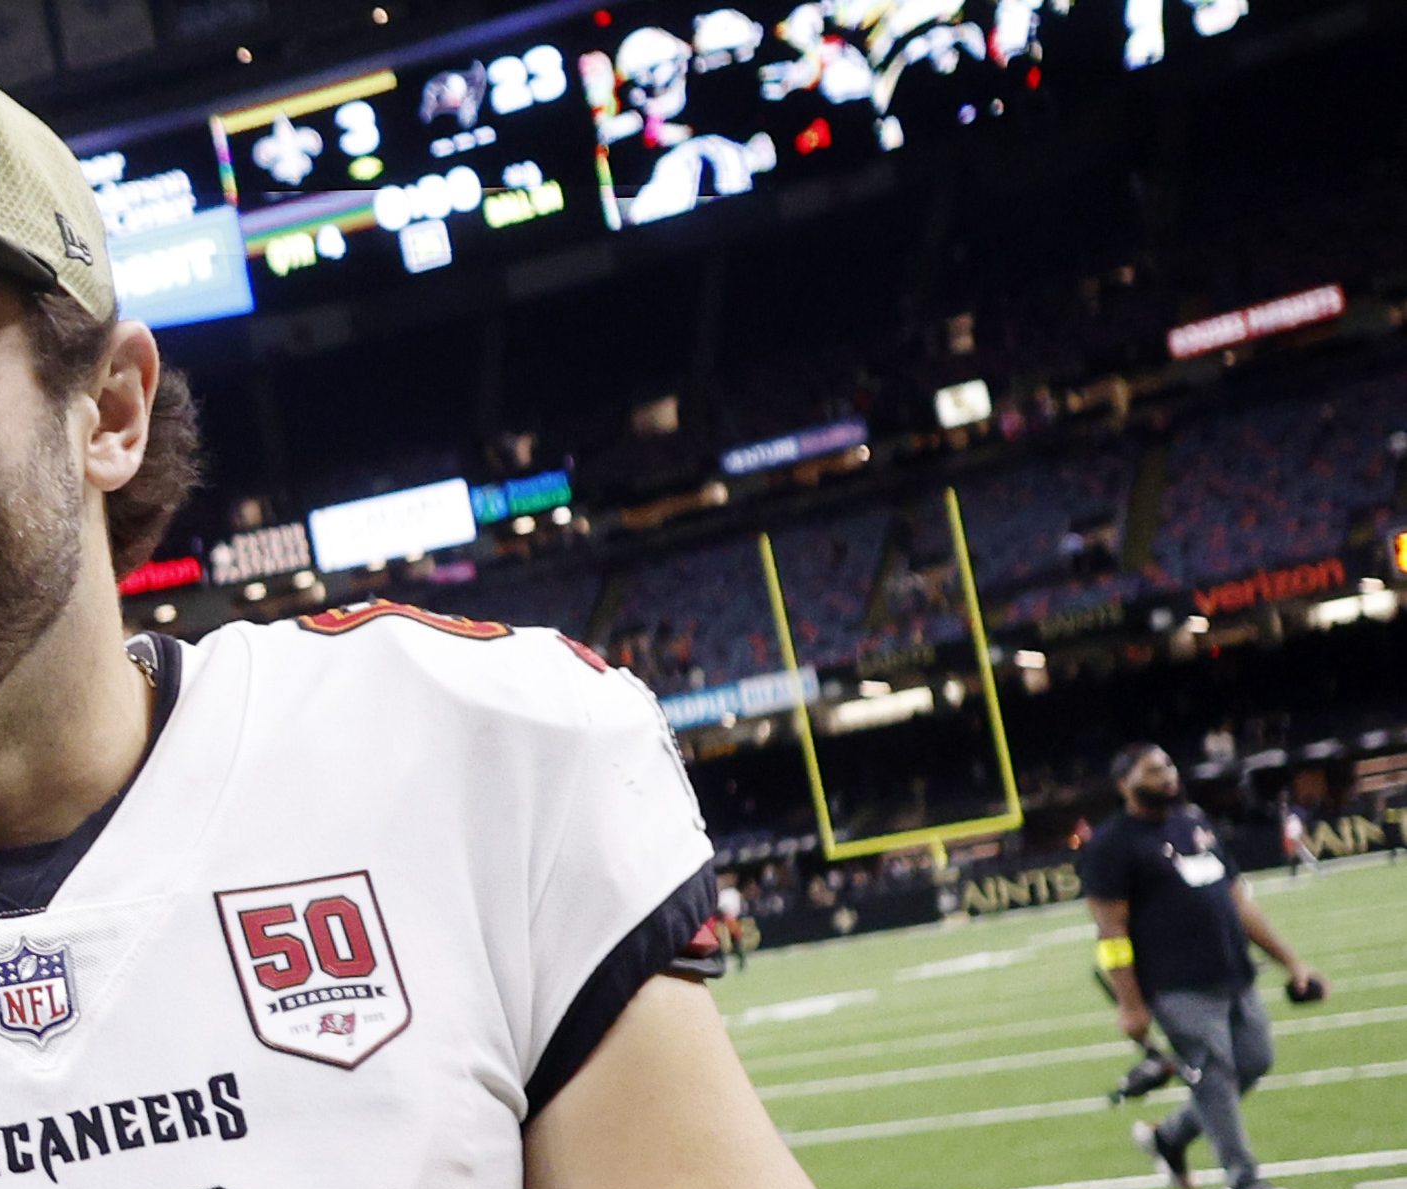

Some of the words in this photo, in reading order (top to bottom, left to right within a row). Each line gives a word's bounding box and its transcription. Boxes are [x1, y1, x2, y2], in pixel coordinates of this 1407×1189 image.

[487, 45, 567, 115] 23
[335, 100, 381, 157] 3
[1193, 557, 1347, 616] verizon
[237, 895, 377, 992] 50
[3, 984, 65, 1028] NFL
[284, 984, 369, 1009] SEASONS
